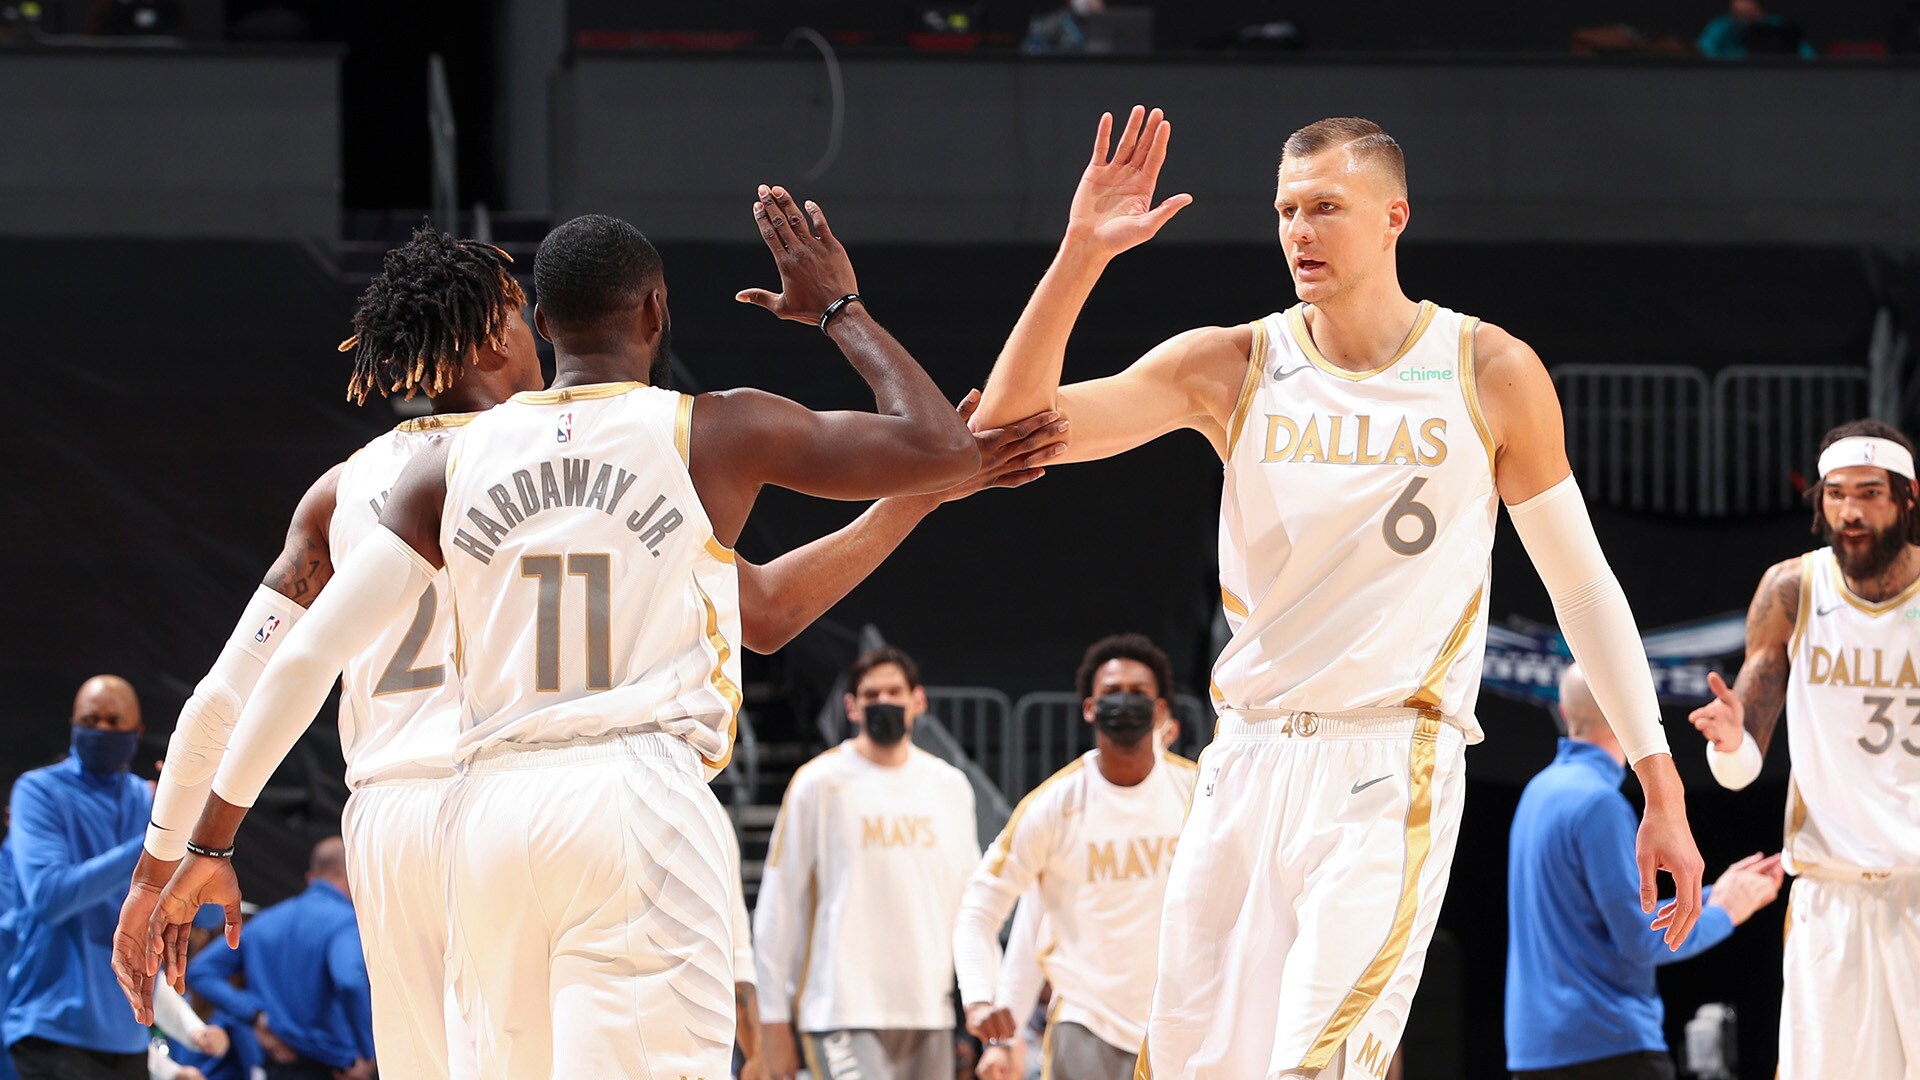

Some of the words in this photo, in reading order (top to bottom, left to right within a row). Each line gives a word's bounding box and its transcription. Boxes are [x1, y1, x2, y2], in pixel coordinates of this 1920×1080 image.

[1399, 366, 1452, 382] chime
[1259, 412, 1448, 467] DALLAS
[453, 457, 638, 566] HARDAWAY
[626, 494, 684, 558] JR.
[1382, 476, 1437, 557] 6
[371, 581, 455, 698] 2
[521, 553, 613, 693] 11
[1808, 646, 1920, 689] DALLA
[862, 815, 938, 850] MAVS
[1354, 1032, 1391, 1080] MA
